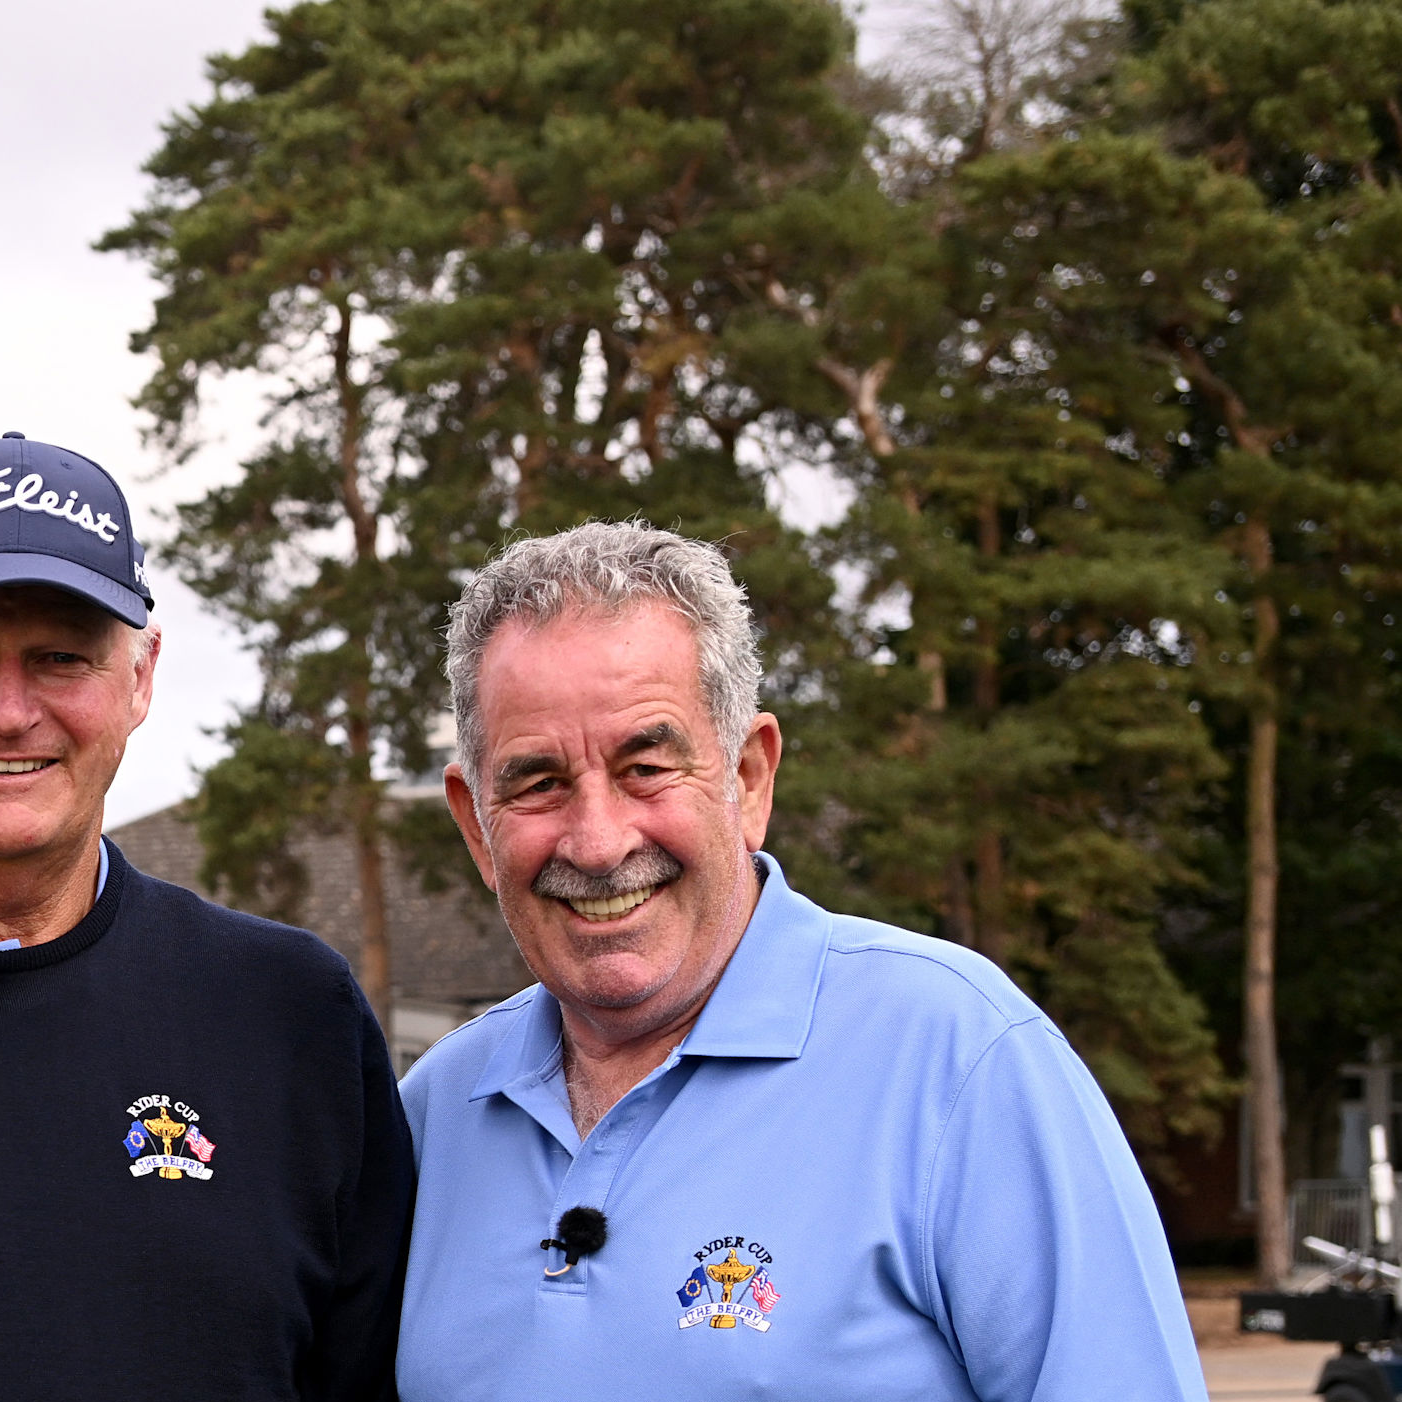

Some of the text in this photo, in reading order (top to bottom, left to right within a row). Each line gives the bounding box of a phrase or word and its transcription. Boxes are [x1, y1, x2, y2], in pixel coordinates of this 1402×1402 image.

[126, 1094, 200, 1122] RYDER CUP
[138, 1157, 203, 1172] THE BELFRY
[693, 1236, 773, 1265] RYDER CUP
[687, 1304, 761, 1320] THE BELFRY
